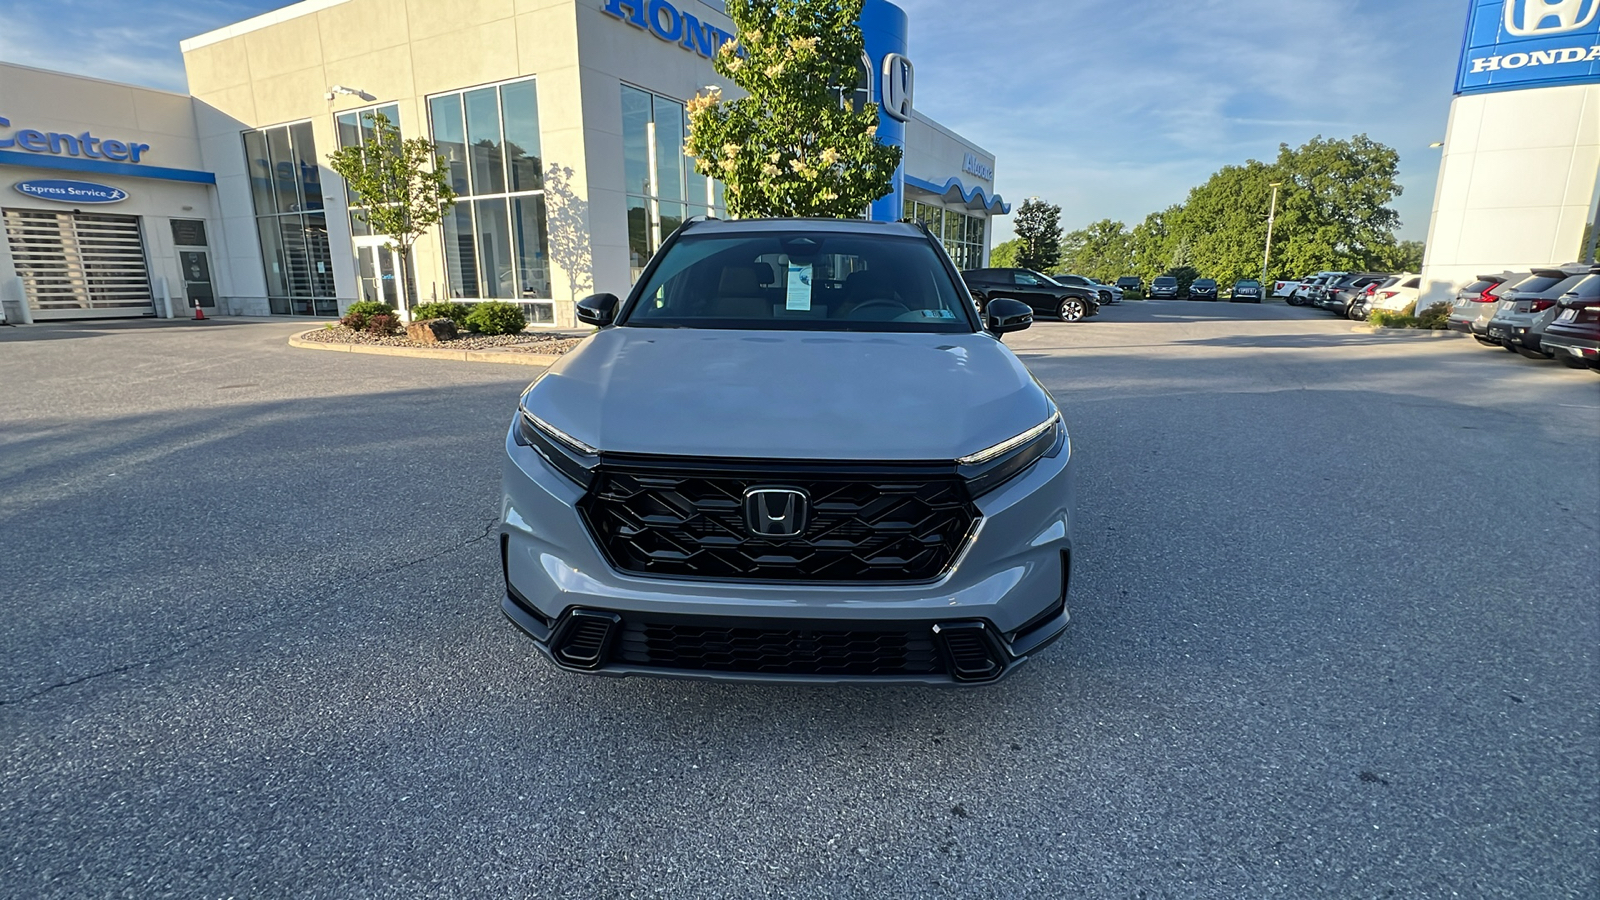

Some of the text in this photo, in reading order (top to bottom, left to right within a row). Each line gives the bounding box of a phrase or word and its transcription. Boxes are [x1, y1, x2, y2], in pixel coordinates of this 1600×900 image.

[601, 0, 748, 59] HON
[22, 183, 107, 197] Express Service
